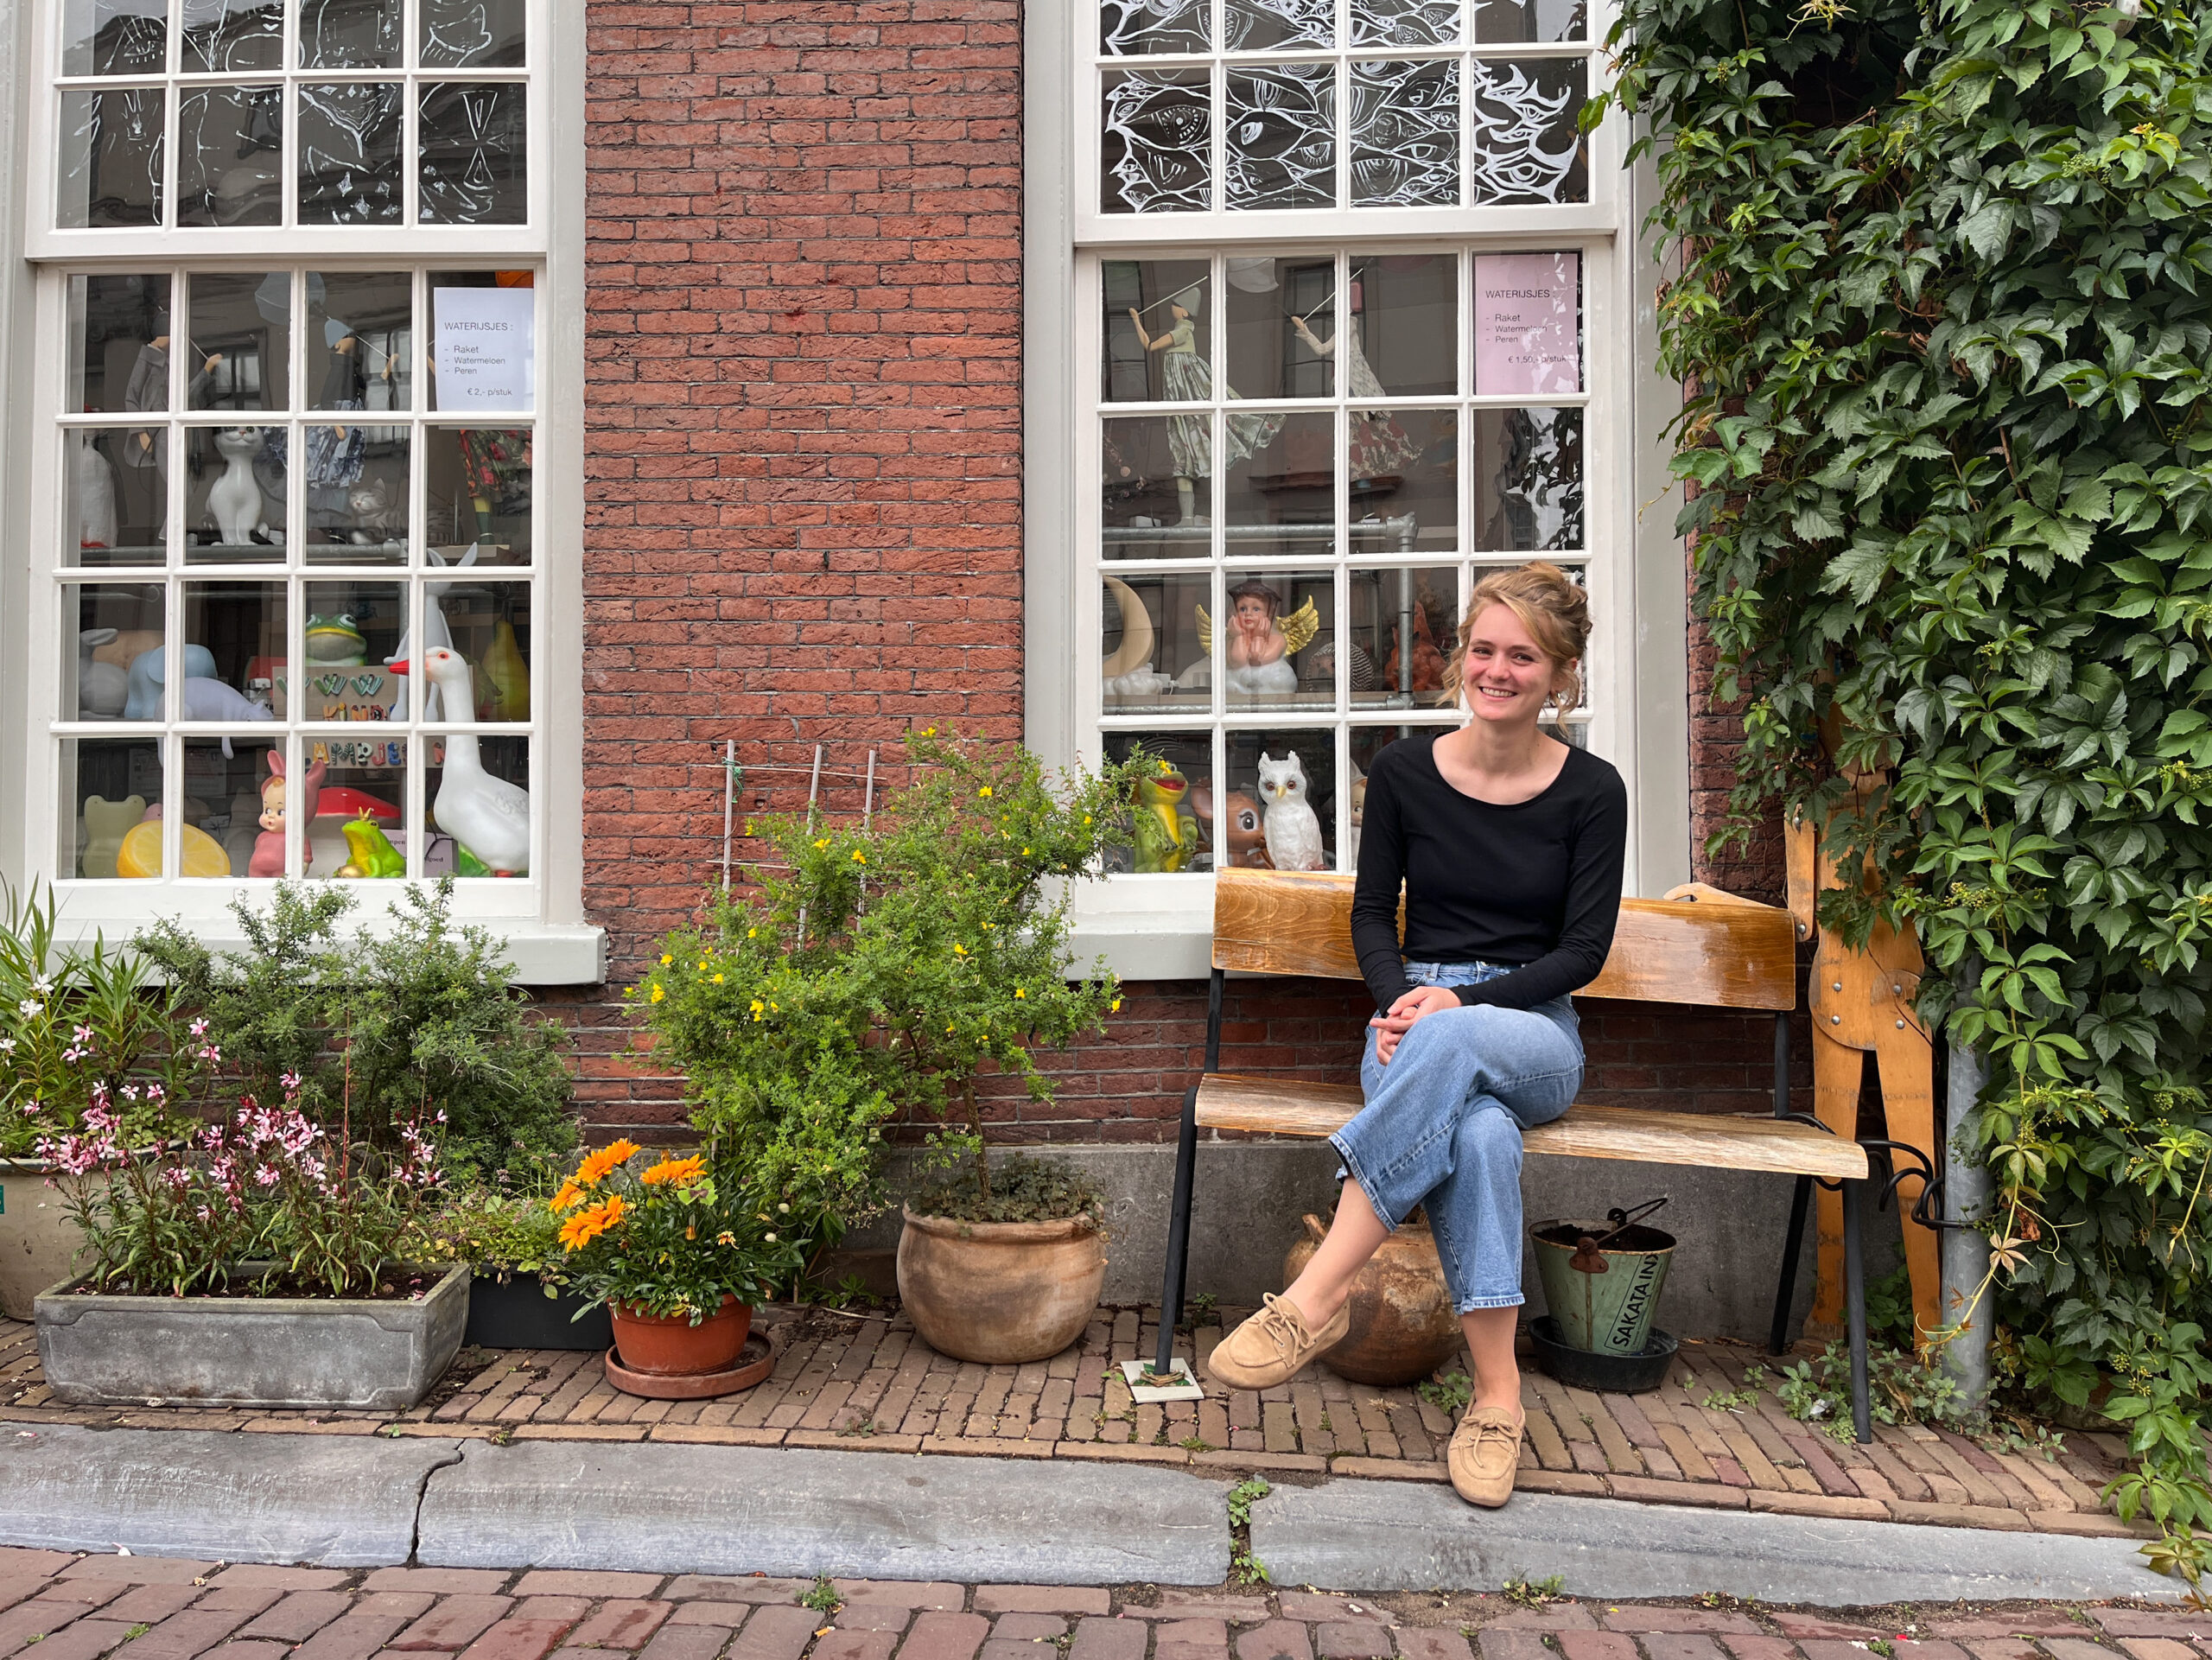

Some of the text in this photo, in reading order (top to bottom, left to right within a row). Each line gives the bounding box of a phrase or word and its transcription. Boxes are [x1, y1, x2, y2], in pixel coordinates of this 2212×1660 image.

[1485, 289, 1550, 298] WATERIJSJES
[1495, 314, 1521, 322] Raket
[444, 321, 508, 331] WATERIJSJES
[305, 741, 408, 766] AMPJE
[1612, 1282, 1650, 1347] SAKATA
